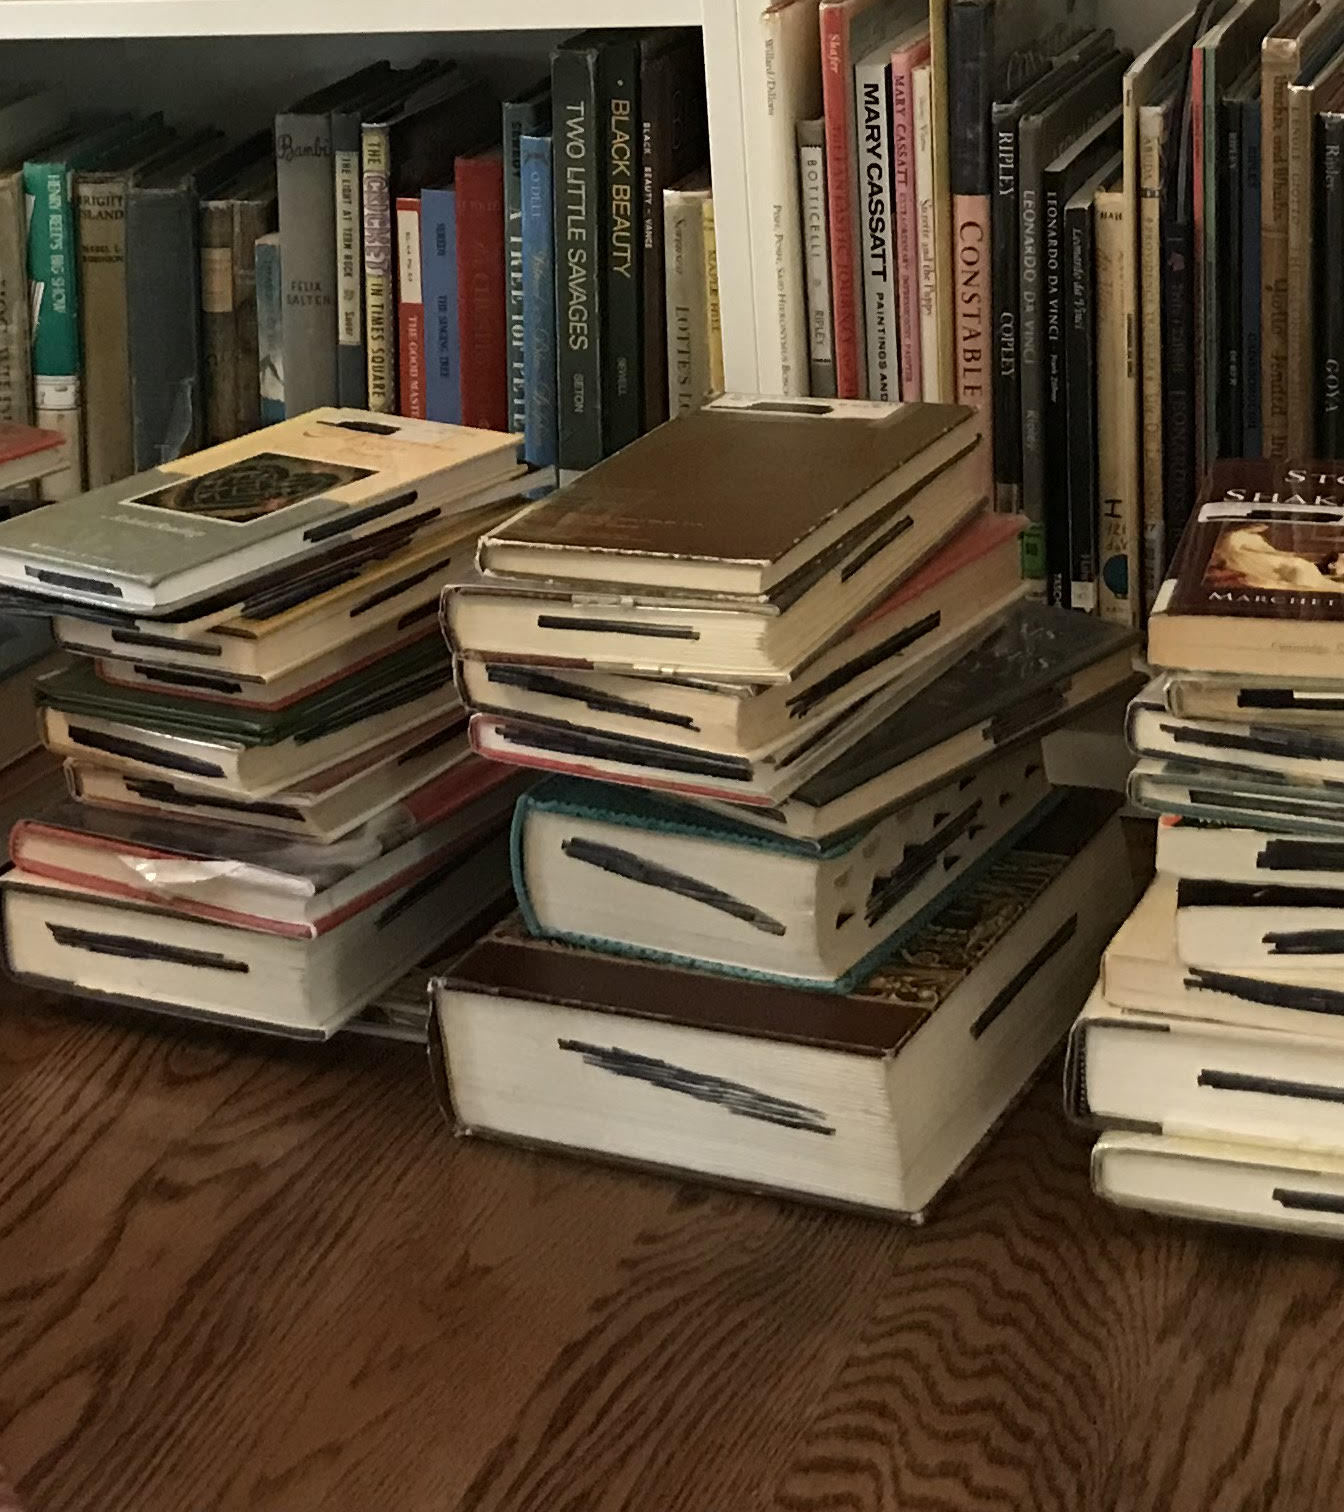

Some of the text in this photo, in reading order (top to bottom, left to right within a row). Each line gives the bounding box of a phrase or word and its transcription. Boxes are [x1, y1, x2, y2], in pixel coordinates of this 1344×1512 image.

[277, 135, 329, 159] Bambi
[370, 142, 382, 166] THE
[643, 123, 652, 154] BLACK
[895, 76, 907, 189] MARY CASSATT
[610, 99, 632, 279] BLACK BEAUTY
[645, 167, 654, 206] BEAUTY
[565, 101, 588, 414] TWO LITTLE SAVAGES SETON
[808, 159, 824, 346] BOTTICELLI RIPLEY
[864, 85, 888, 402] MARY CASSATT PAINTINGS AND
[999, 132, 1016, 377] RIPLEY COPLEY
[1046, 191, 1058, 340] LEONARDO DA VINCI
[287, 295, 331, 306] SALTEN
[291, 281, 324, 291] FELIX
[370, 280, 384, 298] IN
[961, 222, 982, 396] CONSTABLE
[371, 302, 385, 342] TIMES
[371, 345, 386, 399] SQUARE
[1326, 360, 1340, 413] GOYA
